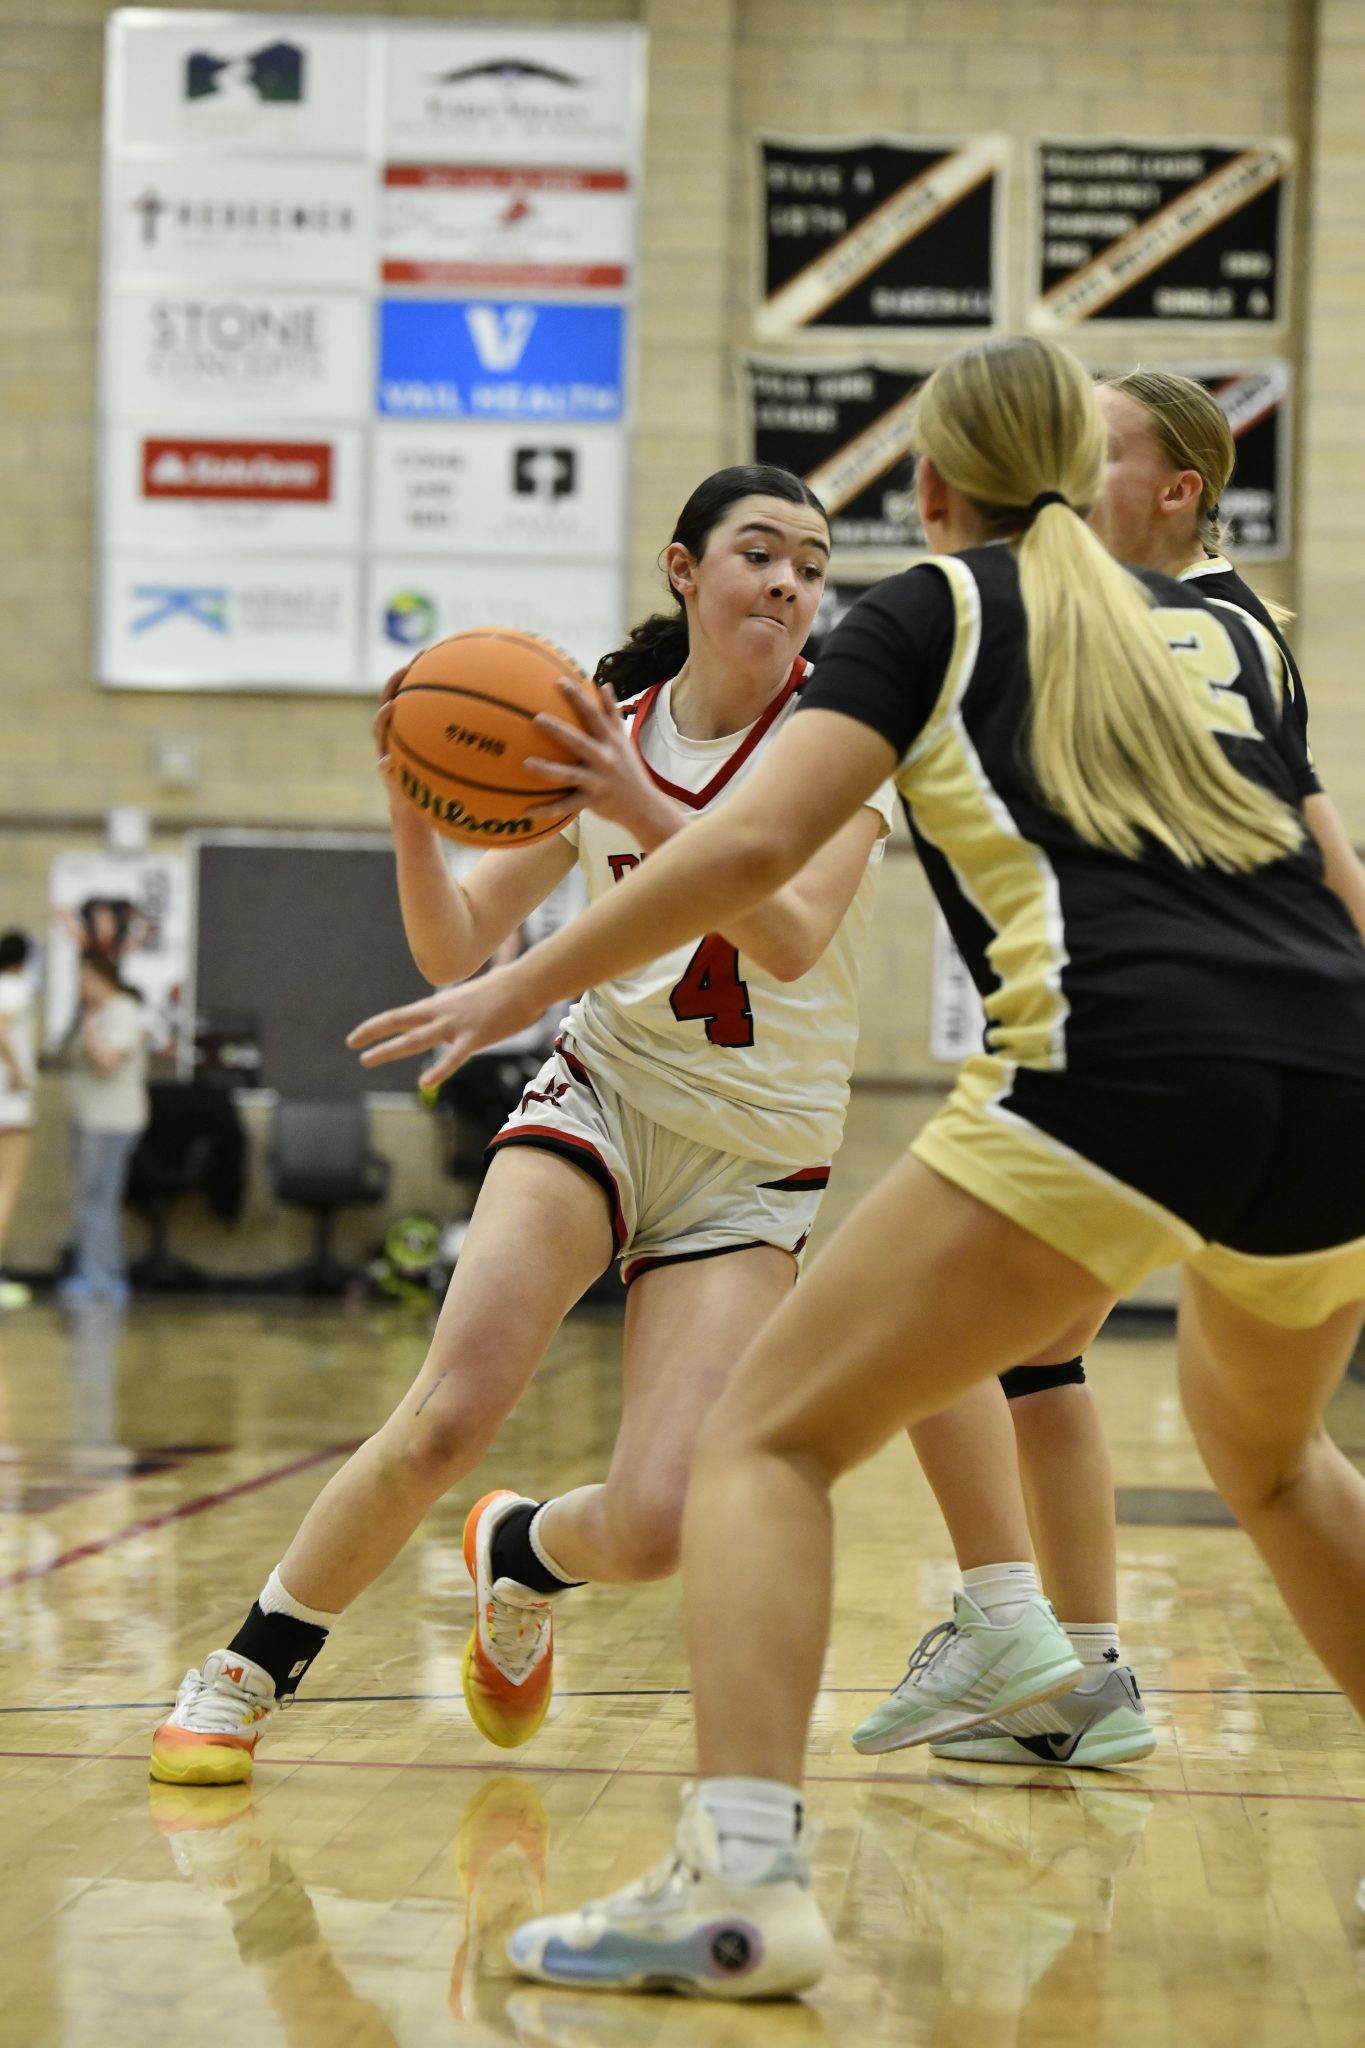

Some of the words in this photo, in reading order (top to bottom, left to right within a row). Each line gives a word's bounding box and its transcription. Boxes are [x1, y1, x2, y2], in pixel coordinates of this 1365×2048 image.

[152, 304, 321, 348] STONE
[150, 353, 323, 380] CONCEPTS
[383, 383, 461, 412] VAIL
[474, 384, 616, 414] HEALTH
[402, 766, 533, 835] Wilson
[669, 931, 755, 1048] 4
